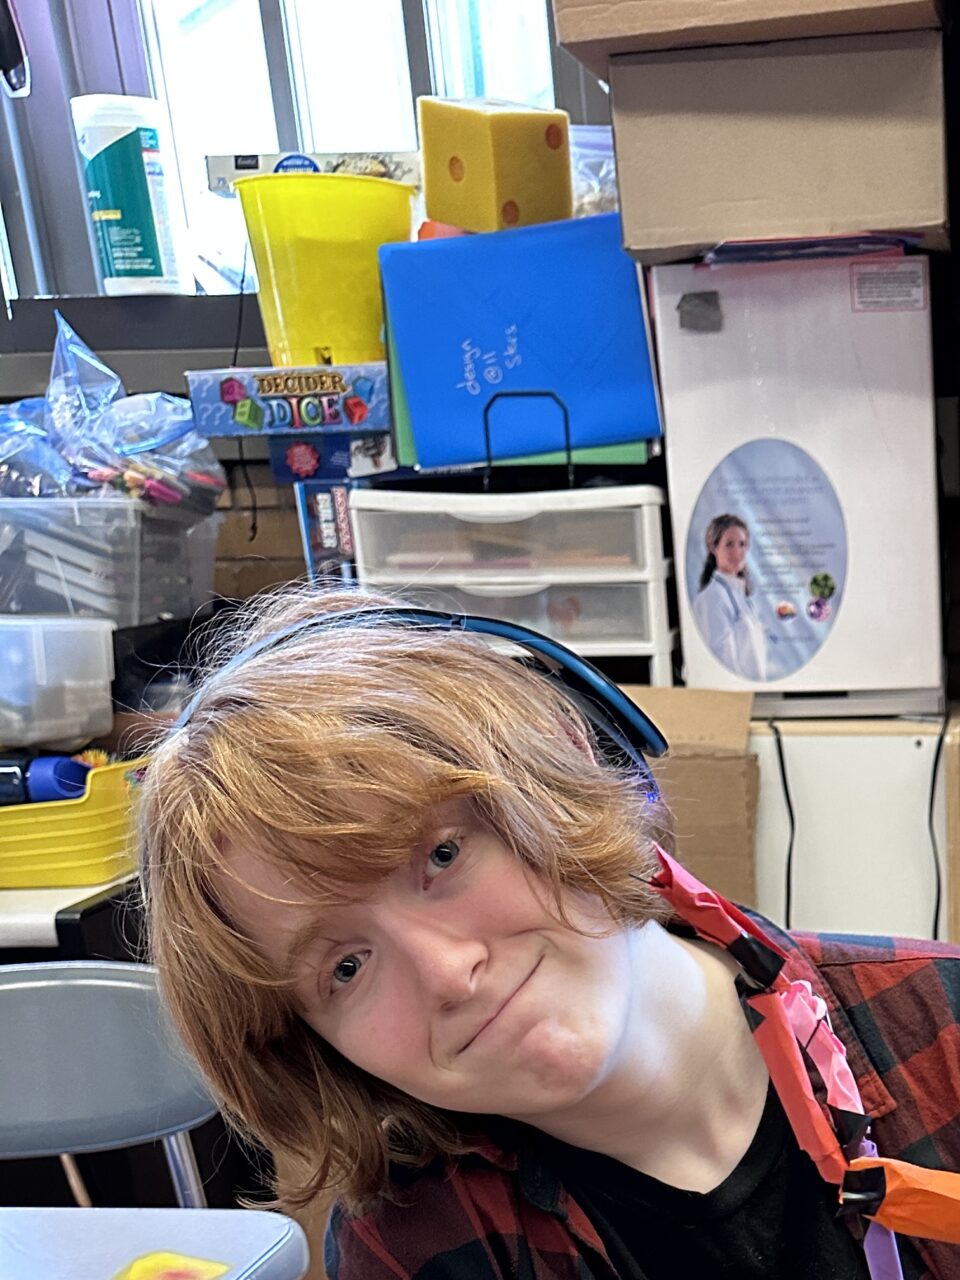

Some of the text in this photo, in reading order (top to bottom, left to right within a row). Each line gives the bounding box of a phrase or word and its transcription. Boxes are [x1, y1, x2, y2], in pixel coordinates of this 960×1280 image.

[257, 372, 347, 395] DECIDER
[455, 338, 481, 395] design
[268, 395, 342, 429] DICE
